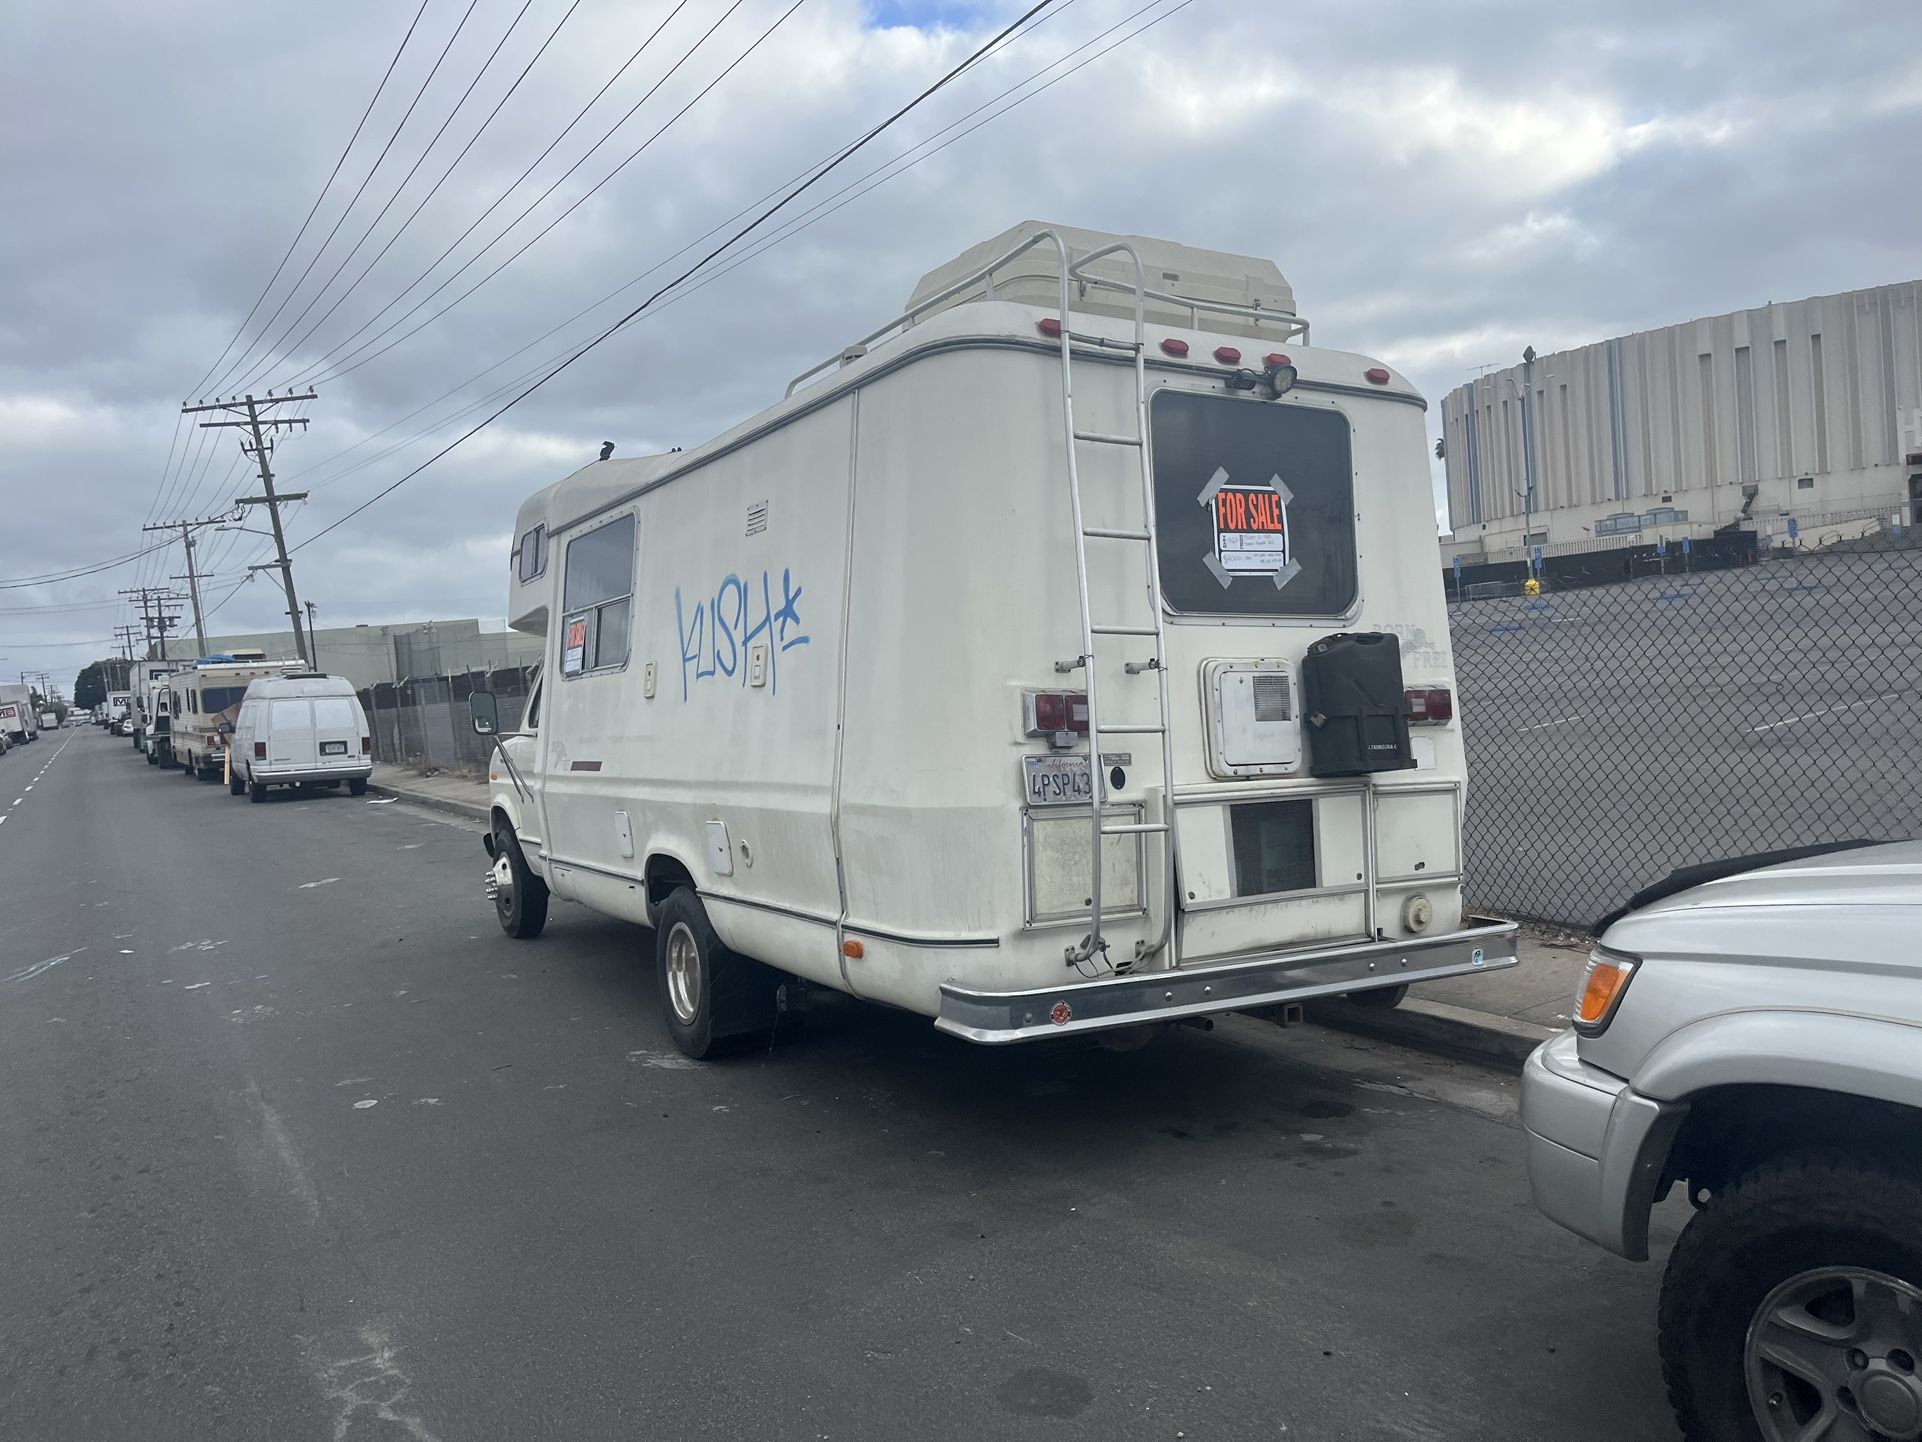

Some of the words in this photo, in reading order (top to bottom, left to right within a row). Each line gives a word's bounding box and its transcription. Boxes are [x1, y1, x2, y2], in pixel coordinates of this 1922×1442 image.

[1217, 492, 1247, 530] FOR
[1248, 492, 1282, 531] SALE
[1032, 772, 1092, 798] 4PSP43
